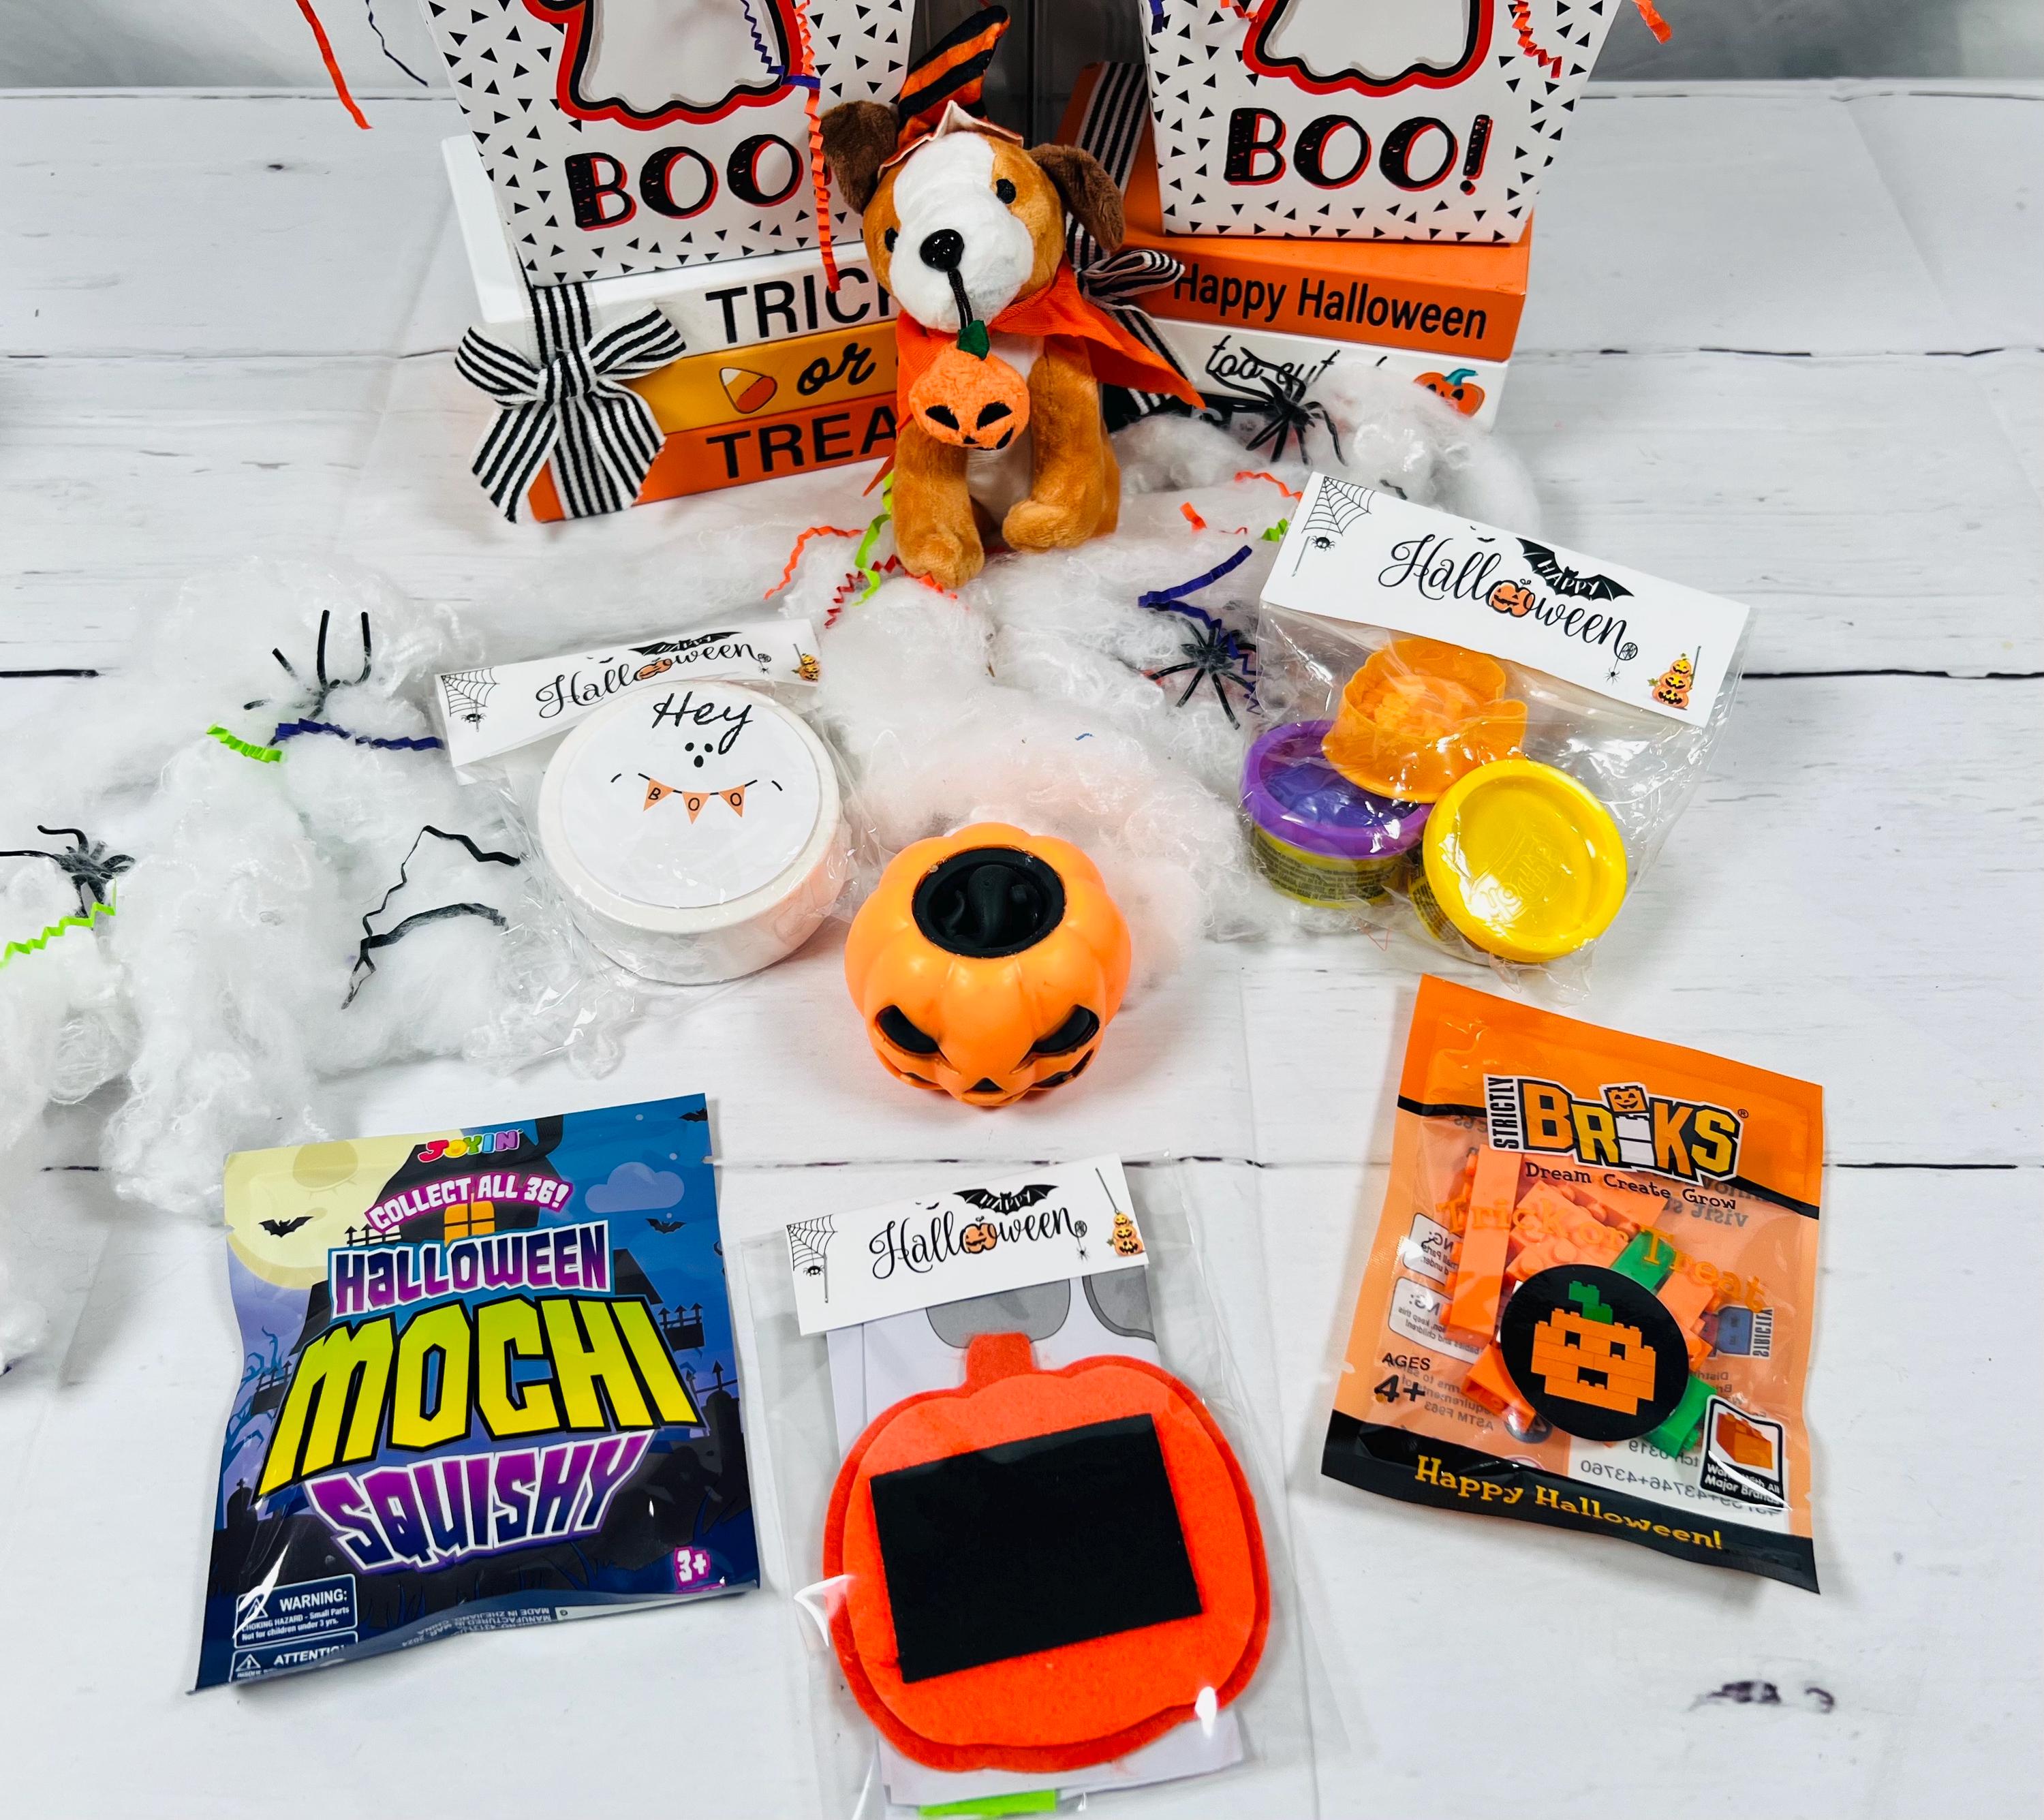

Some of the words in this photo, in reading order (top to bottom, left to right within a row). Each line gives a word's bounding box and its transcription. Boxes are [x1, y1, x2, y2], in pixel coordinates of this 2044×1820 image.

[1224, 107, 1493, 196] BOO!
[564, 134, 833, 232] BOO
[1173, 264, 1286, 324] Happy
[1297, 276, 1487, 340] Halloween
[796, 342, 877, 396] or
[1205, 335, 1263, 380] too
[1276, 349, 1341, 383] cut
[706, 405, 897, 479] TREA
[1378, 534, 1631, 659] Halloween
[1536, 559, 1598, 596] HAPPY
[536, 639, 760, 718] Halloween
[651, 691, 753, 755] Hey
[1487, 1077, 1519, 1150] STRICTLY
[418, 1130, 521, 1163] JOYIN
[369, 1177, 472, 1230] COLLECT
[477, 1174, 518, 1199] ALL
[523, 1175, 570, 1209] 36!
[980, 1190, 1032, 1212] HAPPY
[1524, 1161, 1592, 1184] Dream
[1603, 1173, 1671, 1199] Create
[1682, 1188, 1736, 1210] Grow
[869, 1205, 1081, 1280] Halloween
[1435, 1195, 1570, 1237] Trick
[1574, 1221, 1630, 1248] or
[1641, 1225, 1766, 1313] Treat
[332, 1222, 610, 1318] HALLOWEEN
[1374, 1374, 1426, 1404] 4+
[1381, 1352, 1431, 1372] AGES
[255, 1296, 707, 1503] MOCHI
[308, 1433, 653, 1571] SQUISHY
[1414, 1453, 1524, 1505] Happy
[1534, 1484, 1723, 1551] Halloween!
[1704, 1474, 1739, 1493] Major
[677, 1549, 707, 1582] 3+
[274, 1614, 304, 1627] HAZARD
[309, 1610, 330, 1621] Small
[330, 1606, 350, 1617] Parts
[279, 1588, 348, 1613] WARNING:
[507, 1608, 518, 1617] IN
[520, 1607, 551, 1616] MADE
[241, 1632, 255, 1642] Not
[256, 1630, 267, 1639] for
[266, 1624, 297, 1637] children
[297, 1620, 319, 1633] under
[319, 1619, 325, 1627] 3
[325, 1618, 339, 1629] yrs.
[273, 1644, 346, 1667] ATTENTI
